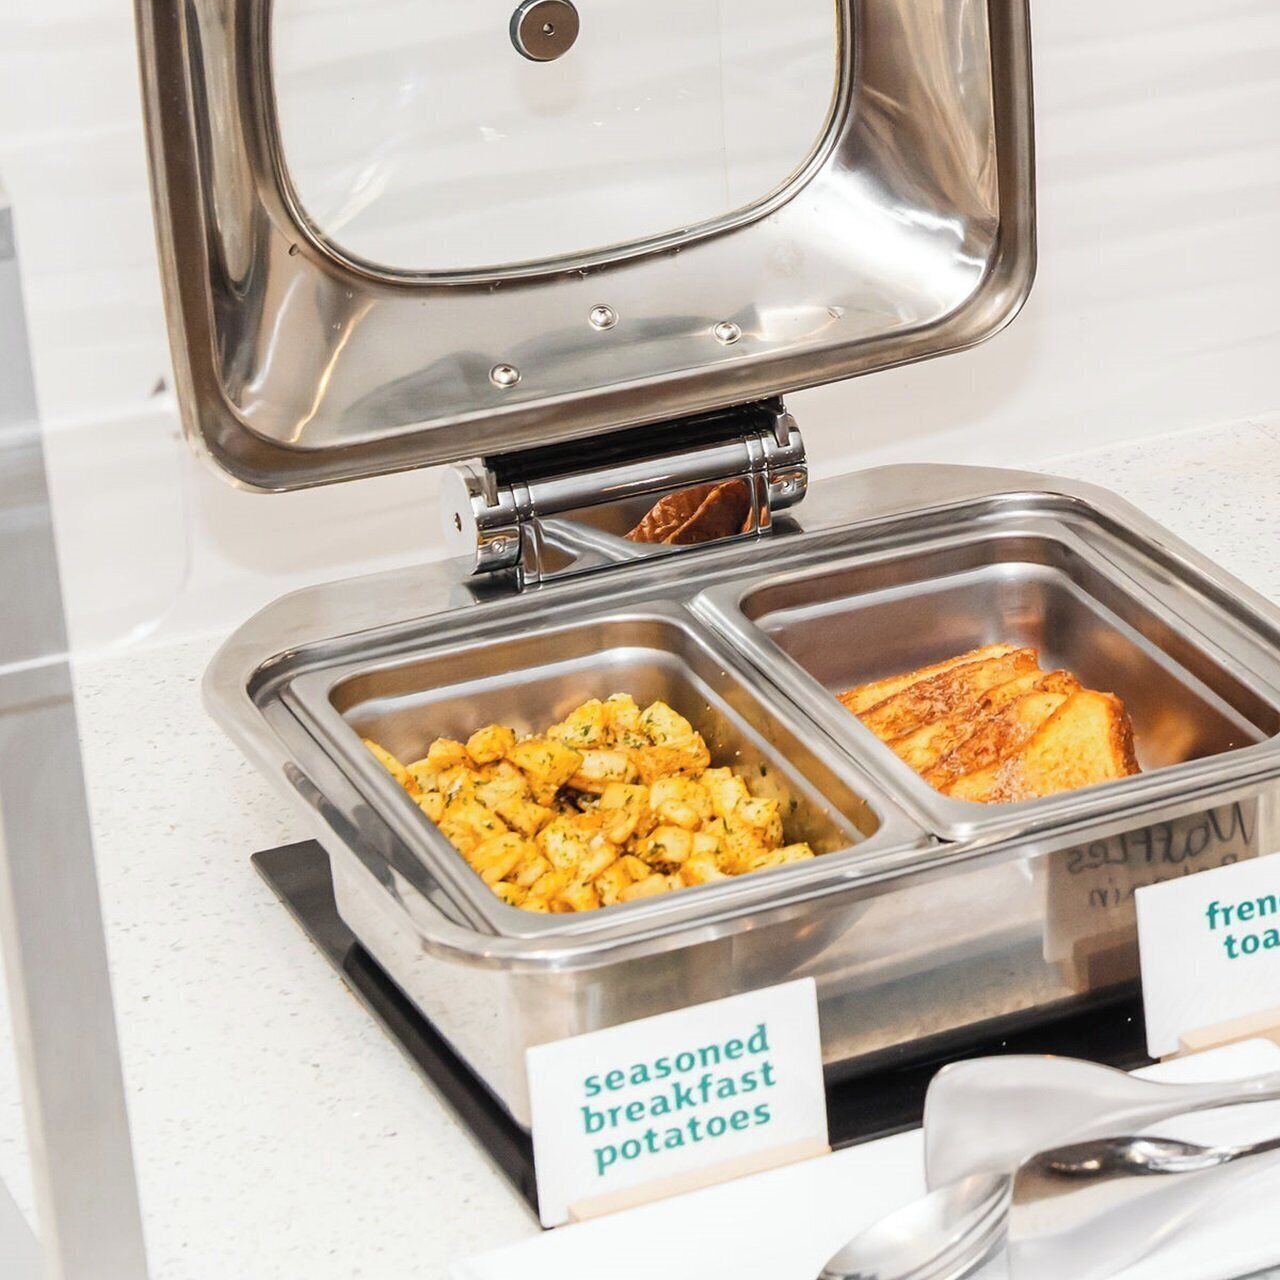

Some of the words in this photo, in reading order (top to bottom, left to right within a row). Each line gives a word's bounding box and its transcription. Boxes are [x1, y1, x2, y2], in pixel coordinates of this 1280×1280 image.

[583, 1024, 770, 1097] seasoned
[581, 1063, 776, 1135] breakfast
[593, 1102, 772, 1176] potatoes
